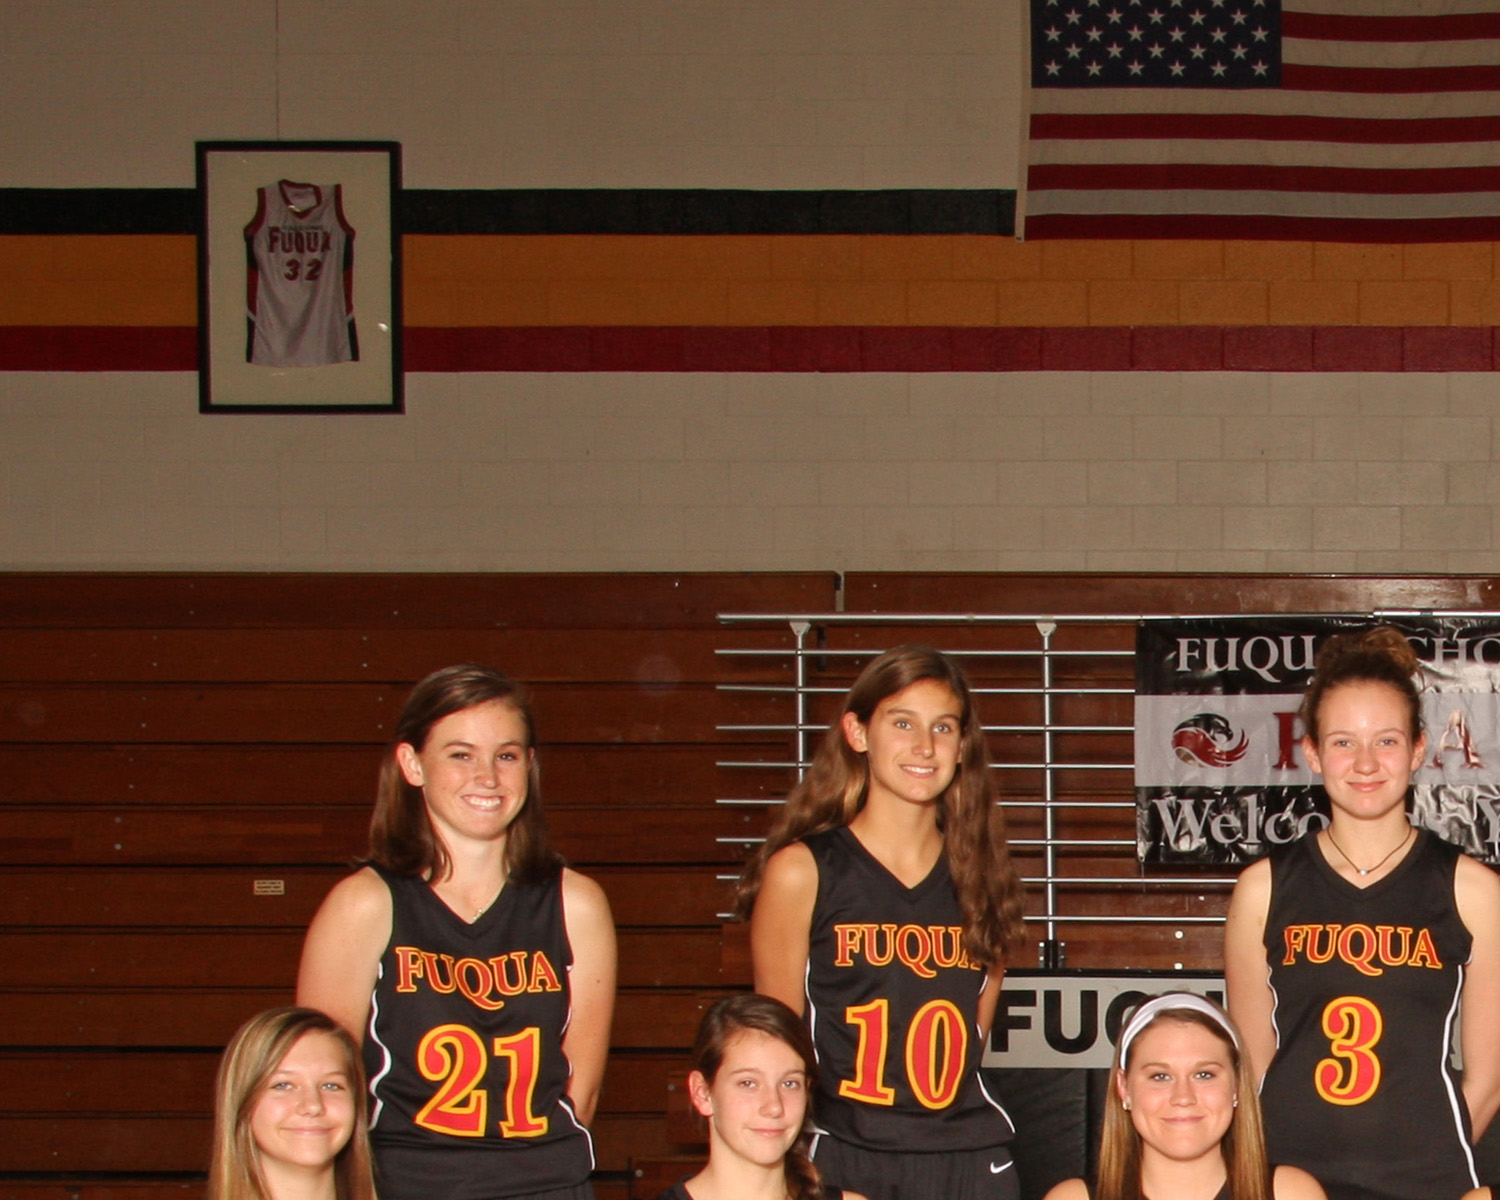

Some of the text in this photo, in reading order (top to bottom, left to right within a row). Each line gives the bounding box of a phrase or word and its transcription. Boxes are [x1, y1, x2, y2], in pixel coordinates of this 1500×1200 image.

[284, 258, 322, 281] 32
[1175, 635, 1317, 683] FUQU
[394, 946, 562, 1011] FUQUA
[1282, 923, 1443, 976] FUQUA
[415, 1023, 548, 1138] 21
[838, 998, 968, 1110] 10
[1314, 996, 1383, 1106] 3
